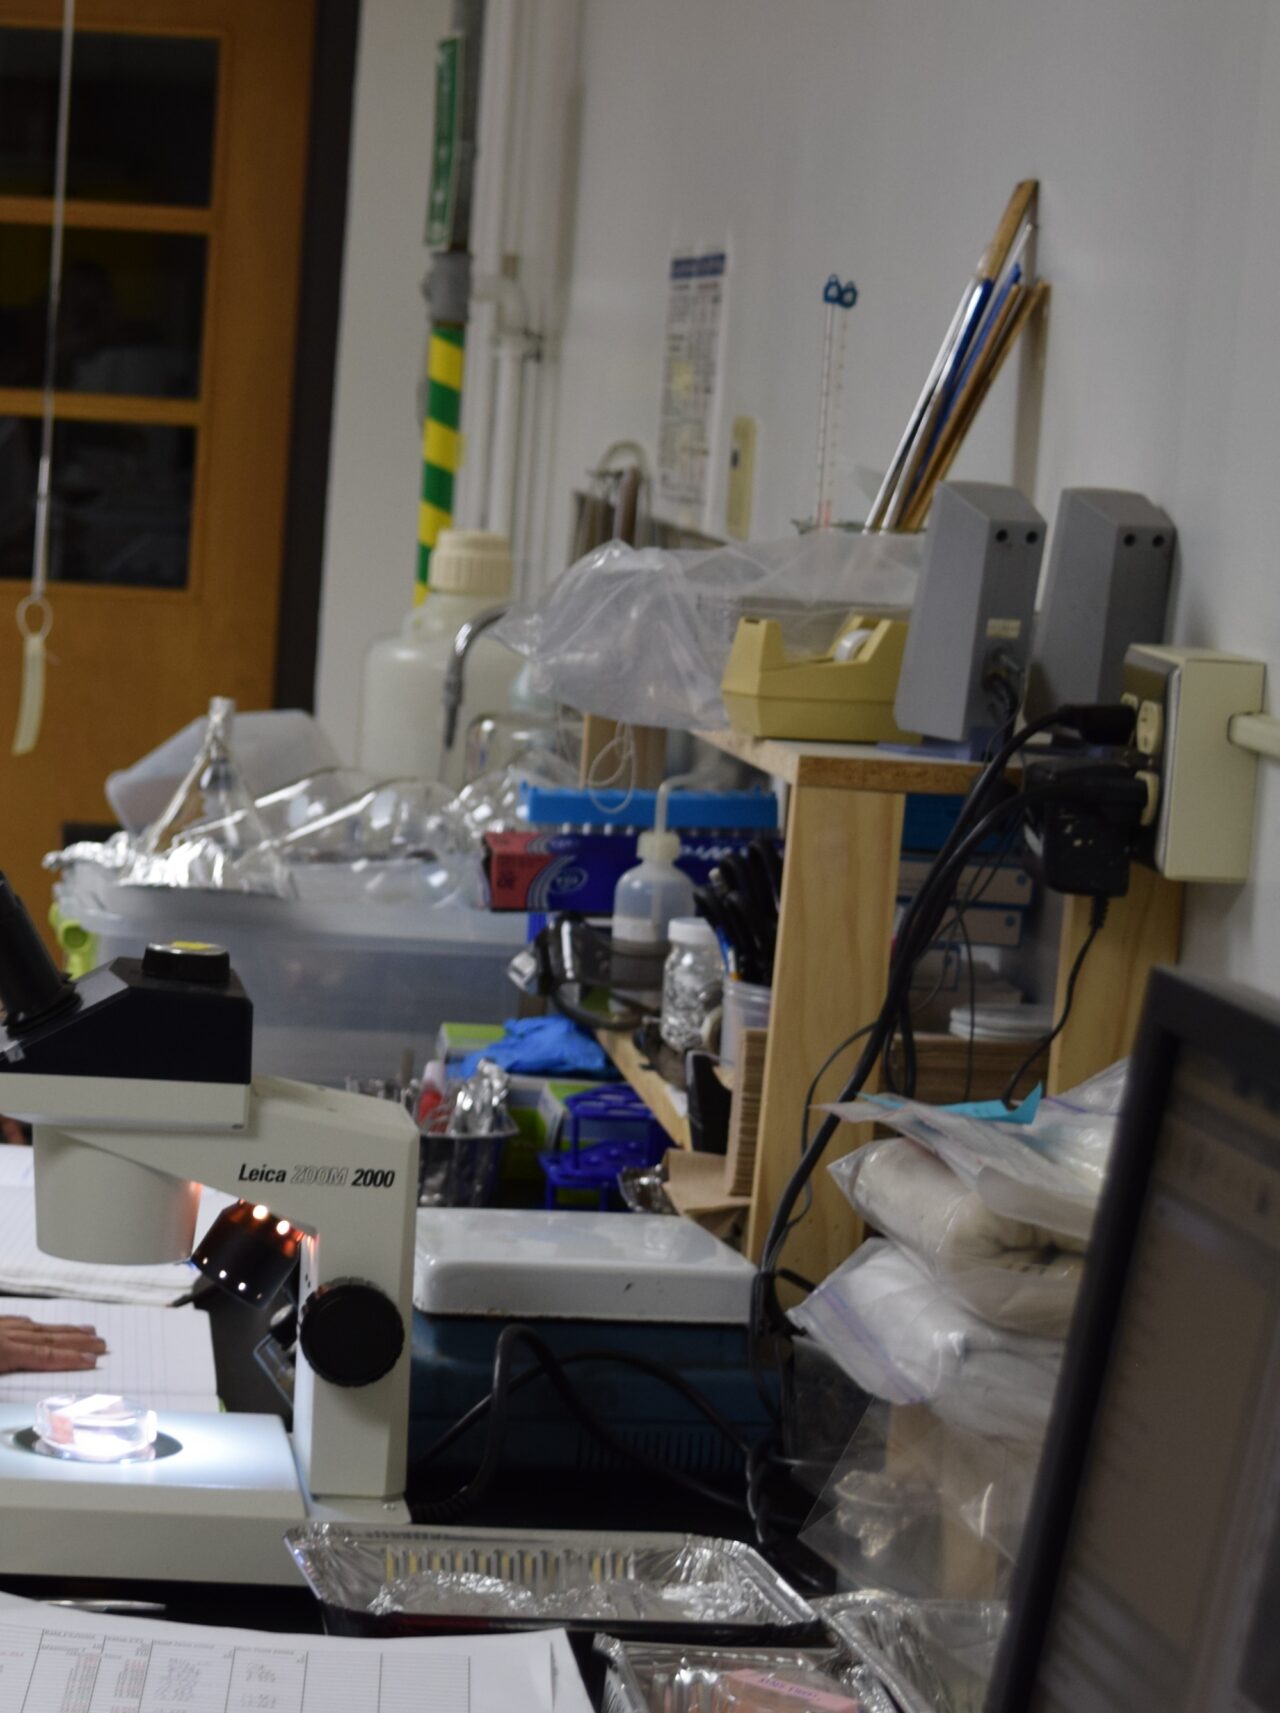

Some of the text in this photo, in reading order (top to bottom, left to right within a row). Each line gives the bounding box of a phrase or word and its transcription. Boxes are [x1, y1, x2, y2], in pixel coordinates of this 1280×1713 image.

[238, 1163, 395, 1188] Leica ZOOM 2000
